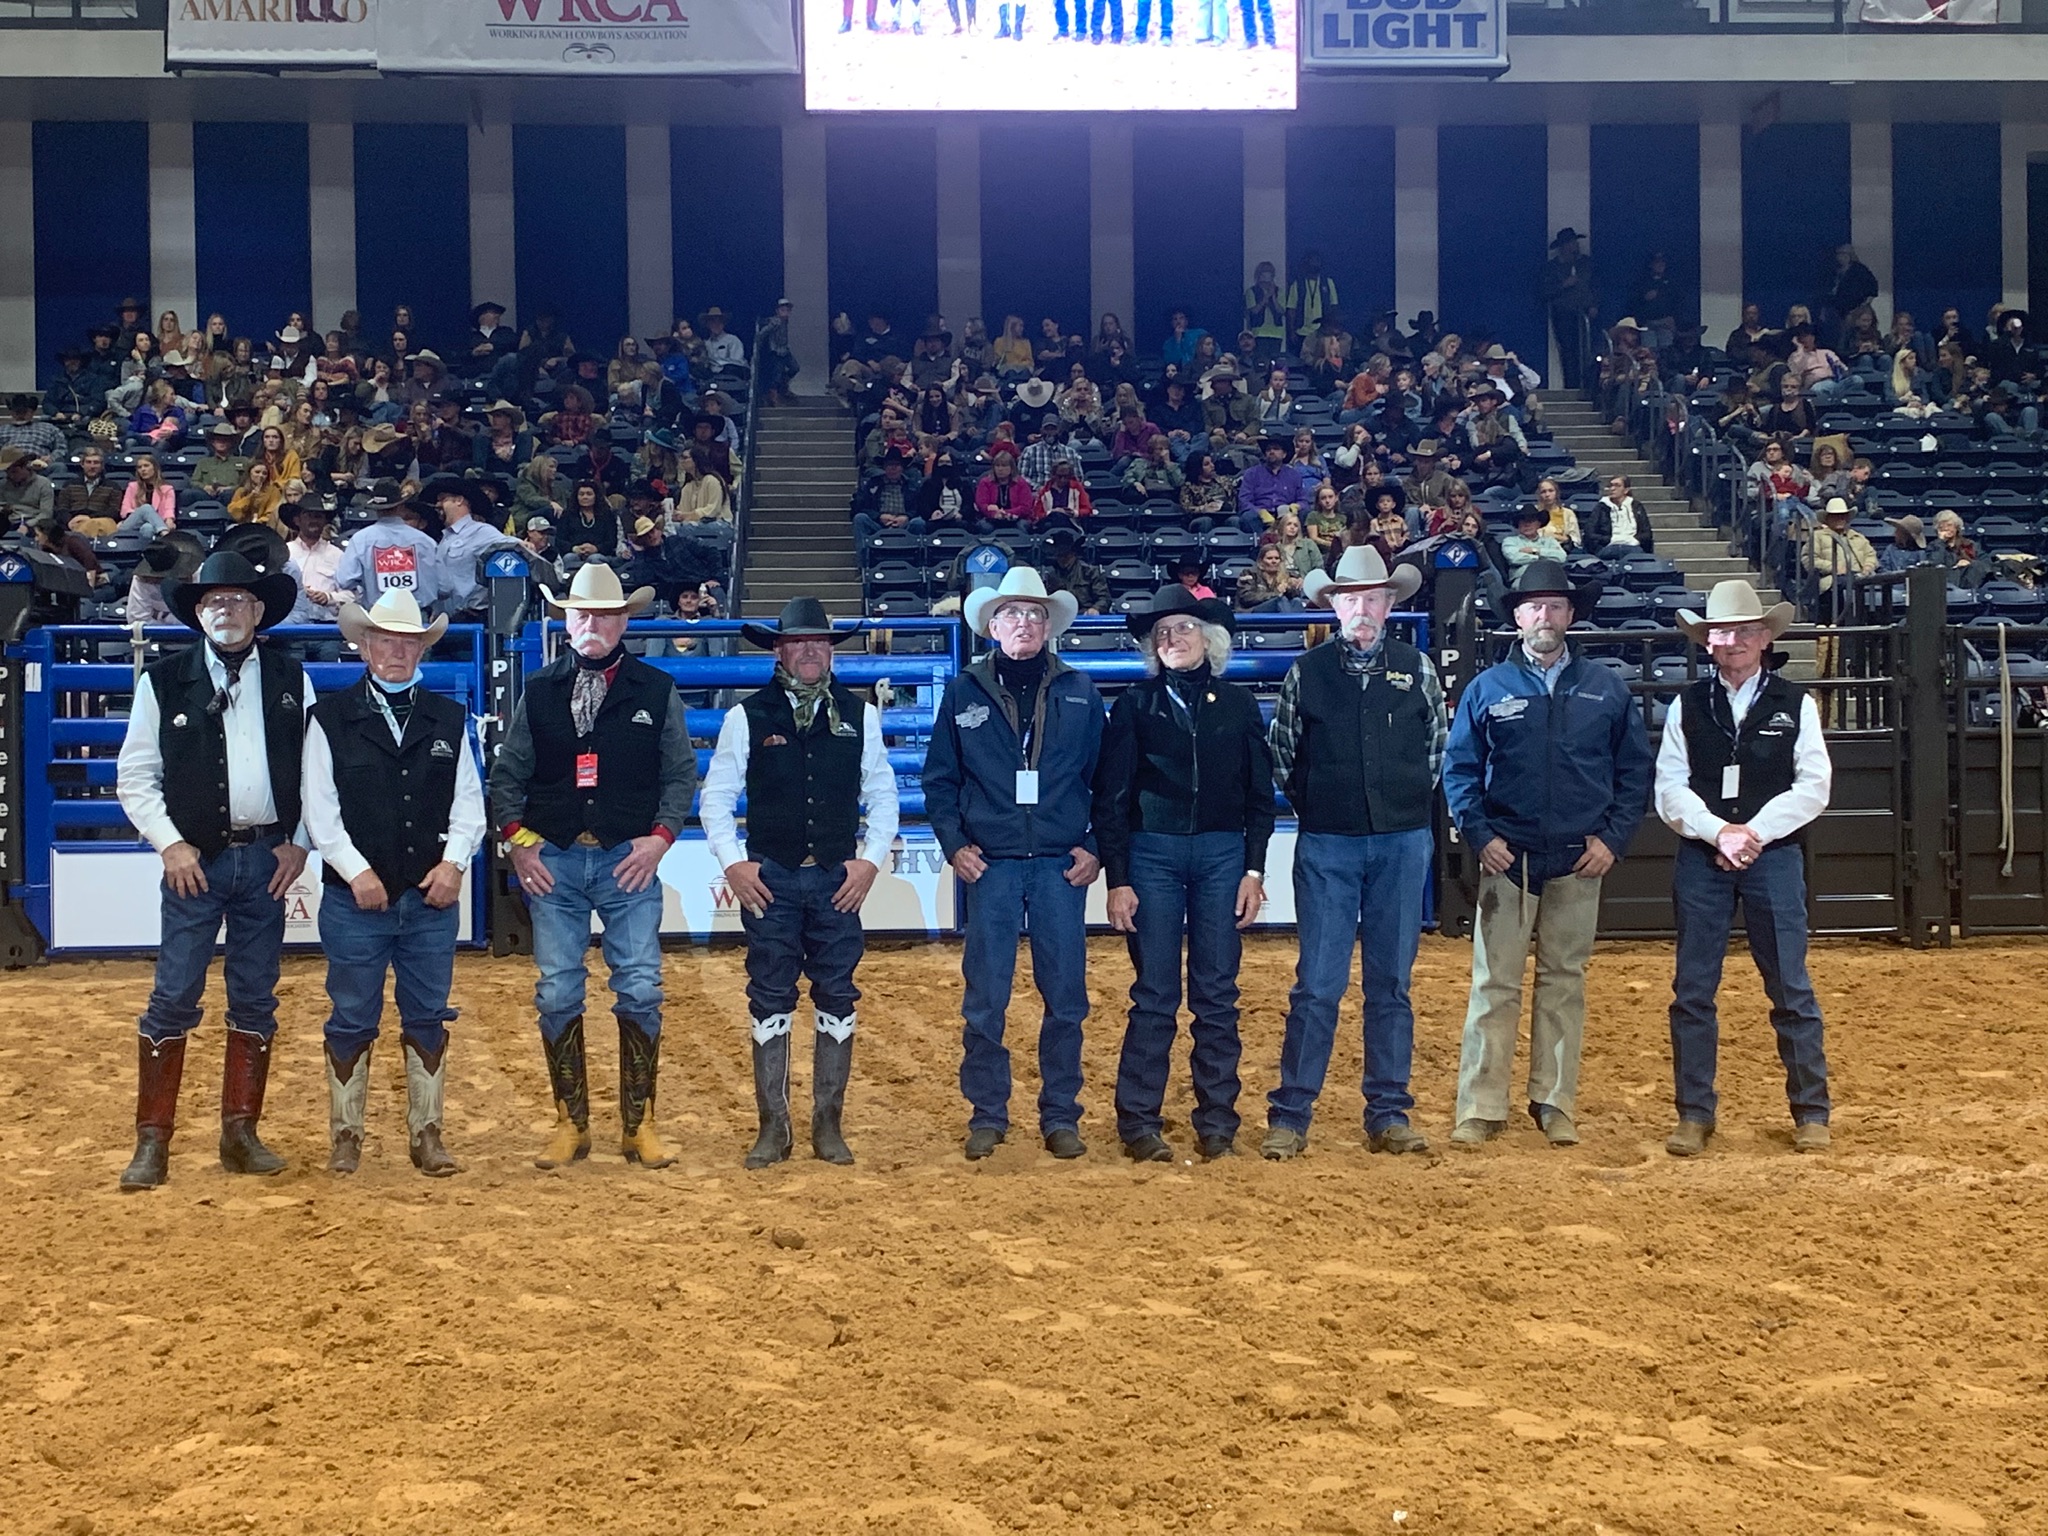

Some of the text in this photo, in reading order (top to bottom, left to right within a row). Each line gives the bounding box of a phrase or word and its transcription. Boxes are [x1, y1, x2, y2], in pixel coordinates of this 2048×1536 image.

[489, 29, 688, 40] WORKING RANCH COWBOYS ASSOCIATION
[1323, 13, 1487, 49] LIGHT
[383, 575, 413, 588] 108
